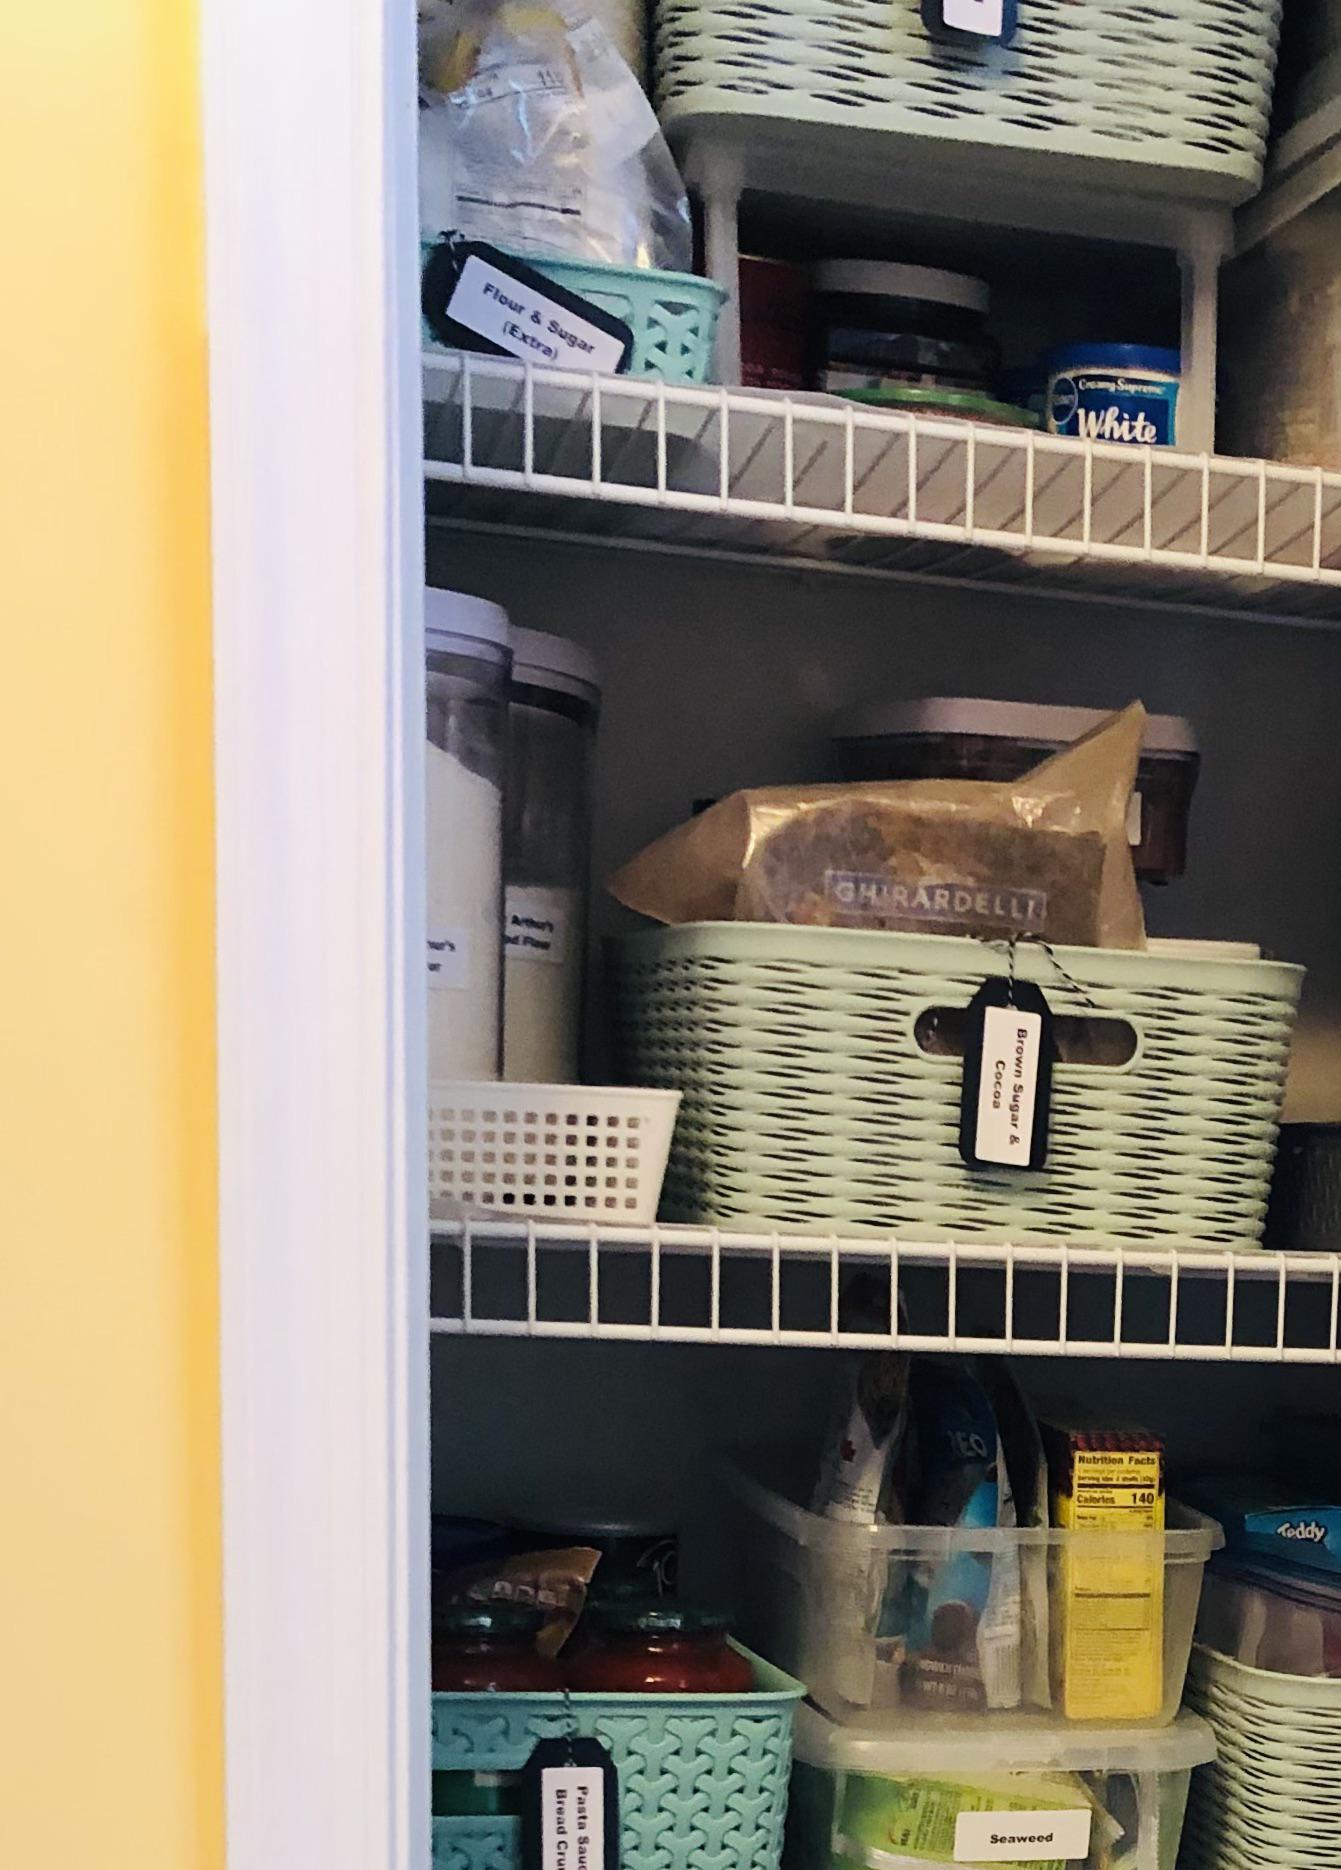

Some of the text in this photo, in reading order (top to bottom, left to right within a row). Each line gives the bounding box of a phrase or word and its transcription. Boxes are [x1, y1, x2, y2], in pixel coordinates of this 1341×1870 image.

[481, 281, 597, 358] Flour & Sugar
[501, 318, 560, 362] (Extra)
[1076, 406, 1158, 444] White
[834, 882, 1036, 921] GHIRARDELLI
[1013, 1028, 1028, 1078] Brown
[992, 1059, 1006, 1109] Cocoa
[1008, 1083, 1025, 1130] Sugar
[1077, 1455, 1156, 1466] Nutrition Facts
[1076, 1492, 1155, 1505] Calories 140
[1276, 1520, 1328, 1544] Teddy
[555, 1788, 568, 1835] Bread
[576, 1786, 590, 1831] Pasta
[989, 1832, 1054, 1845] Seaweed
